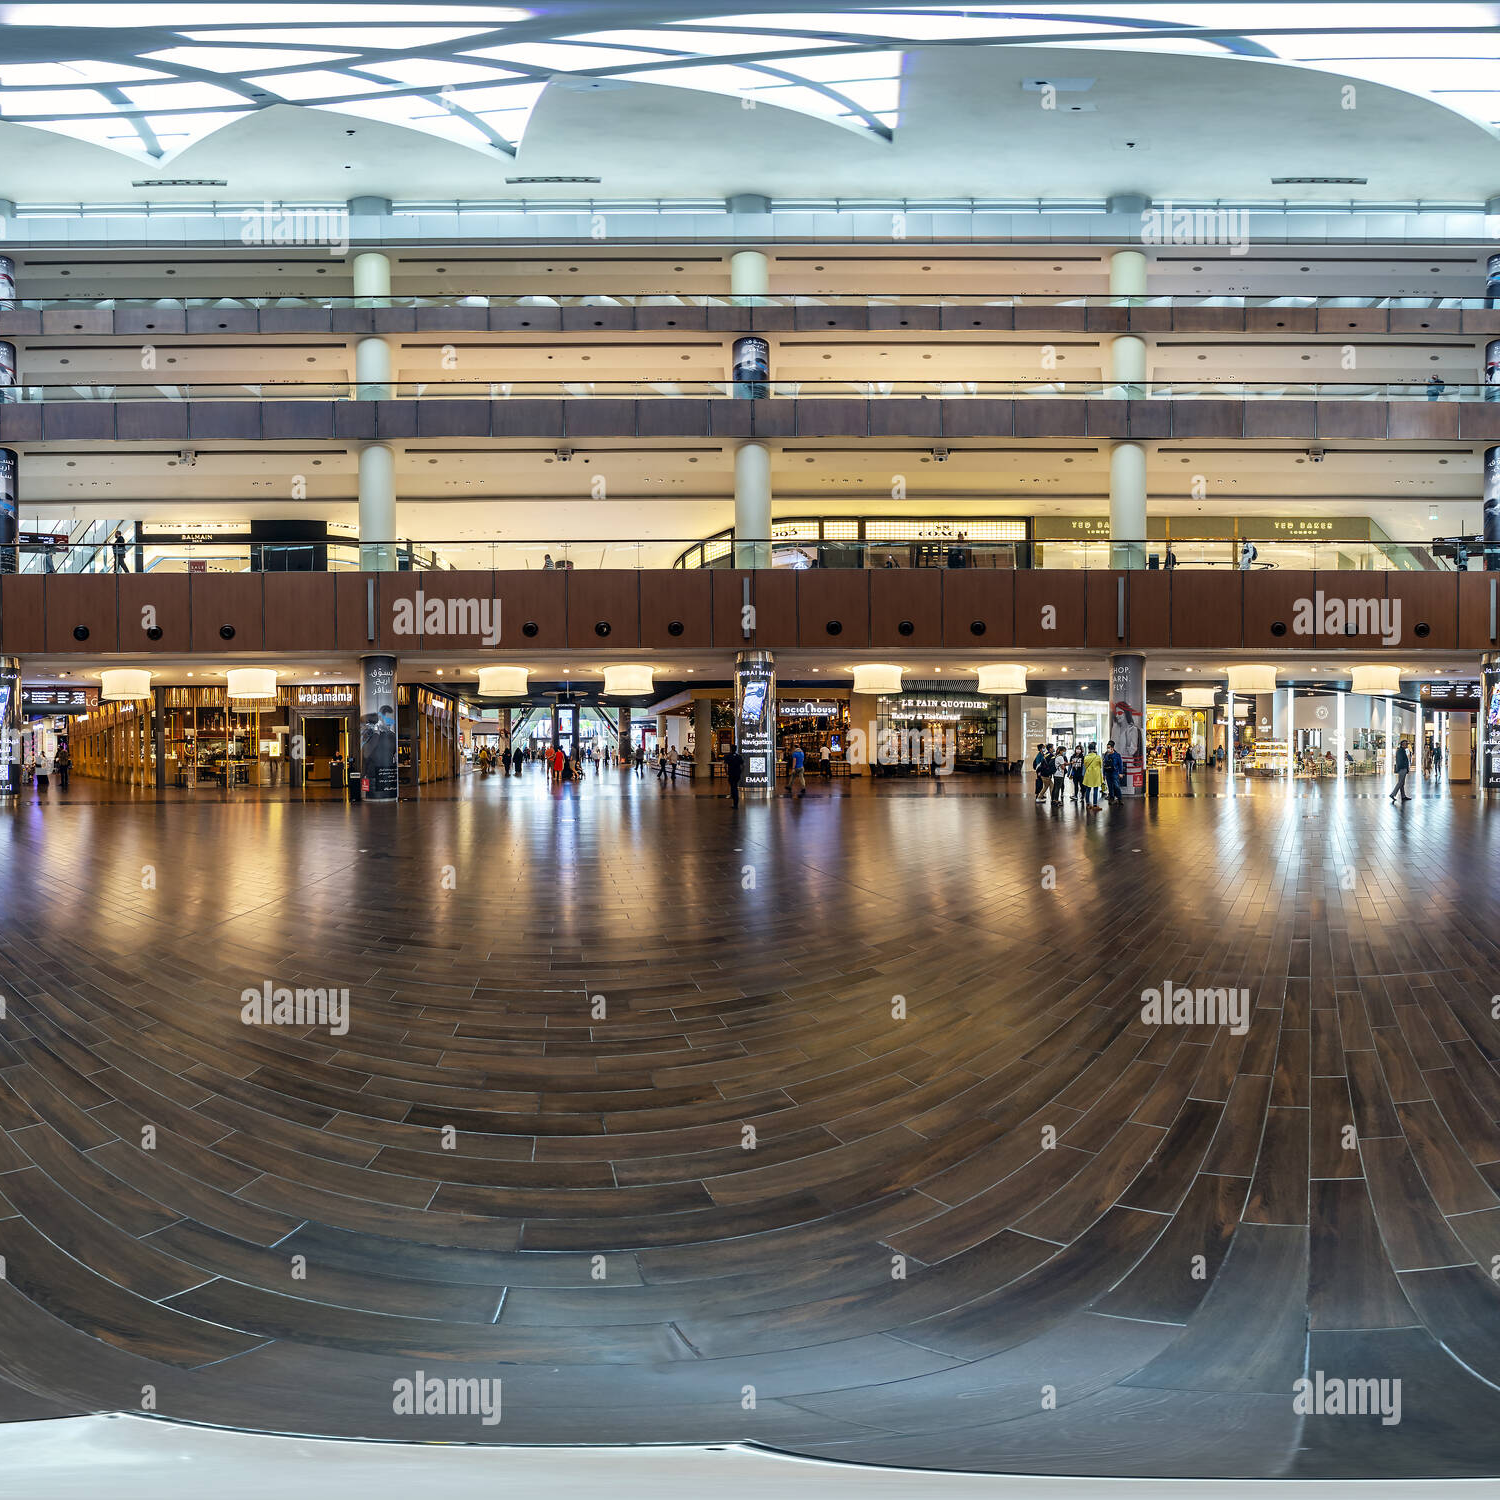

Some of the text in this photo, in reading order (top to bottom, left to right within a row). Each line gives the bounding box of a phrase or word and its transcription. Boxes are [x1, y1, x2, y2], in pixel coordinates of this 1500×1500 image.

[86, 698, 98, 706] LG
[299, 692, 353, 704] wagamama
[940, 700, 988, 708] QUOTIDIEN
